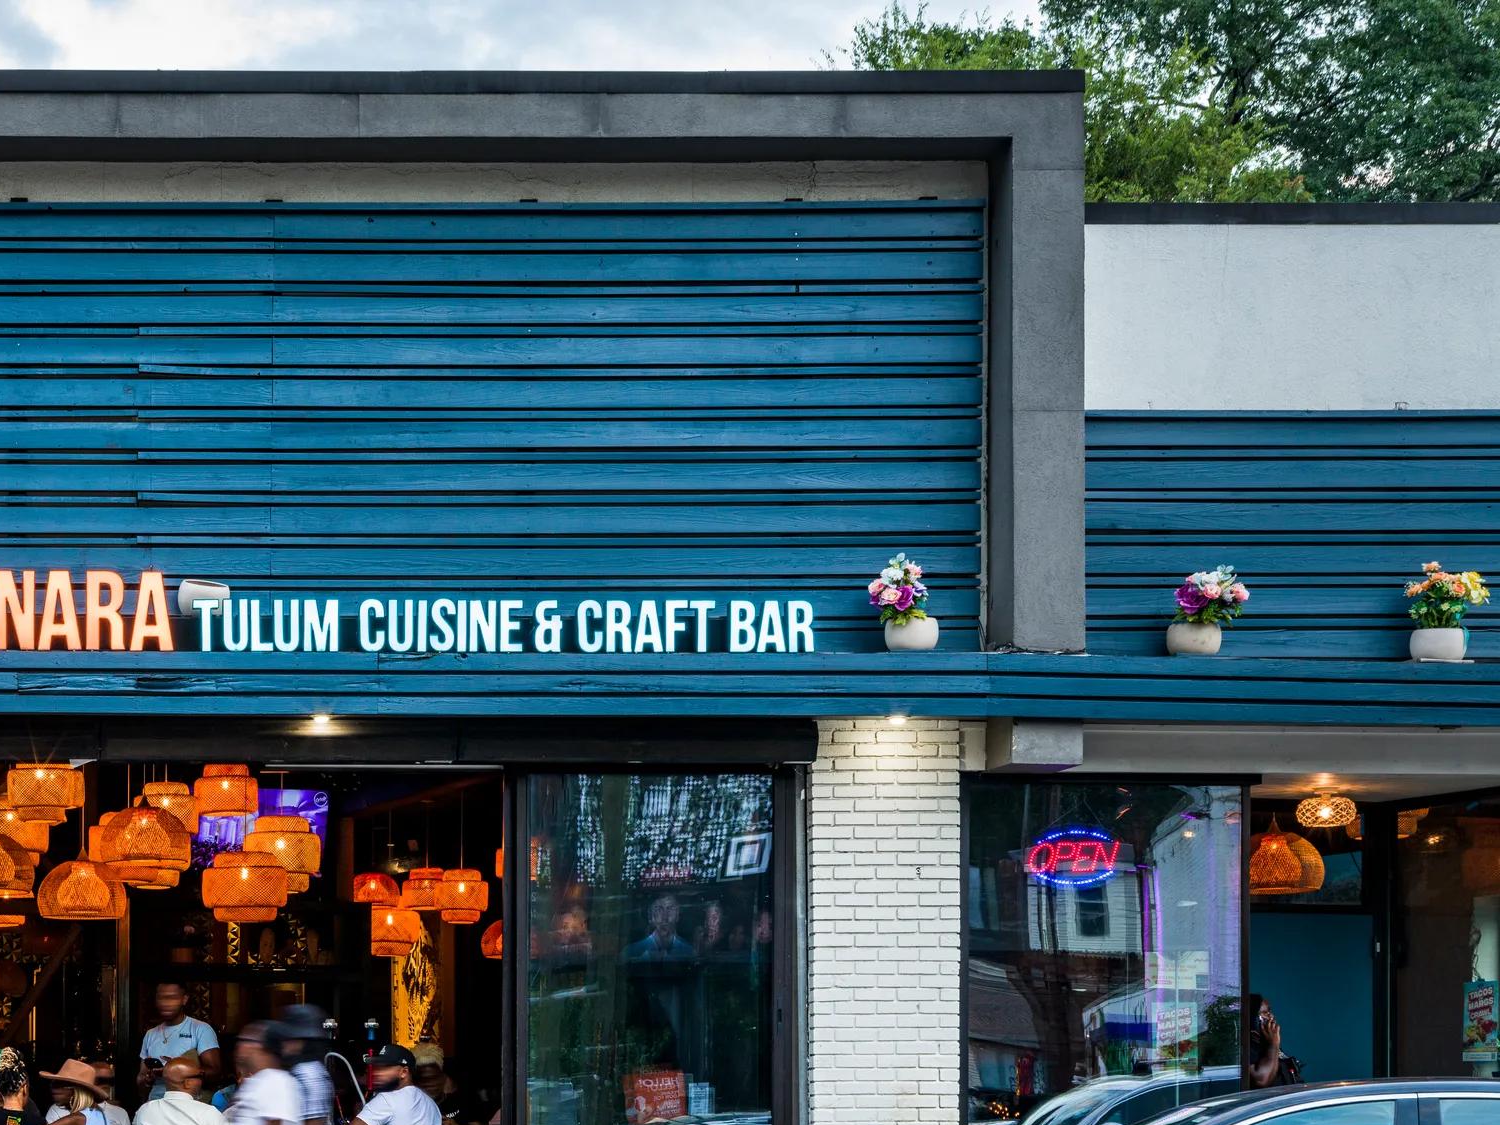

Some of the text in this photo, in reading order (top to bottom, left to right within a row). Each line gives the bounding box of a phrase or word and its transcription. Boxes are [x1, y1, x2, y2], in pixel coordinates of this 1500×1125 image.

[192, 599, 339, 652] TULUM
[359, 598, 524, 653] CUISINE
[534, 599, 563, 653] &
[576, 599, 715, 653] CRAFT
[729, 600, 815, 653] BAR
[1028, 840, 1120, 872] OPEN
[1468, 987, 1493, 1000] TACOS
